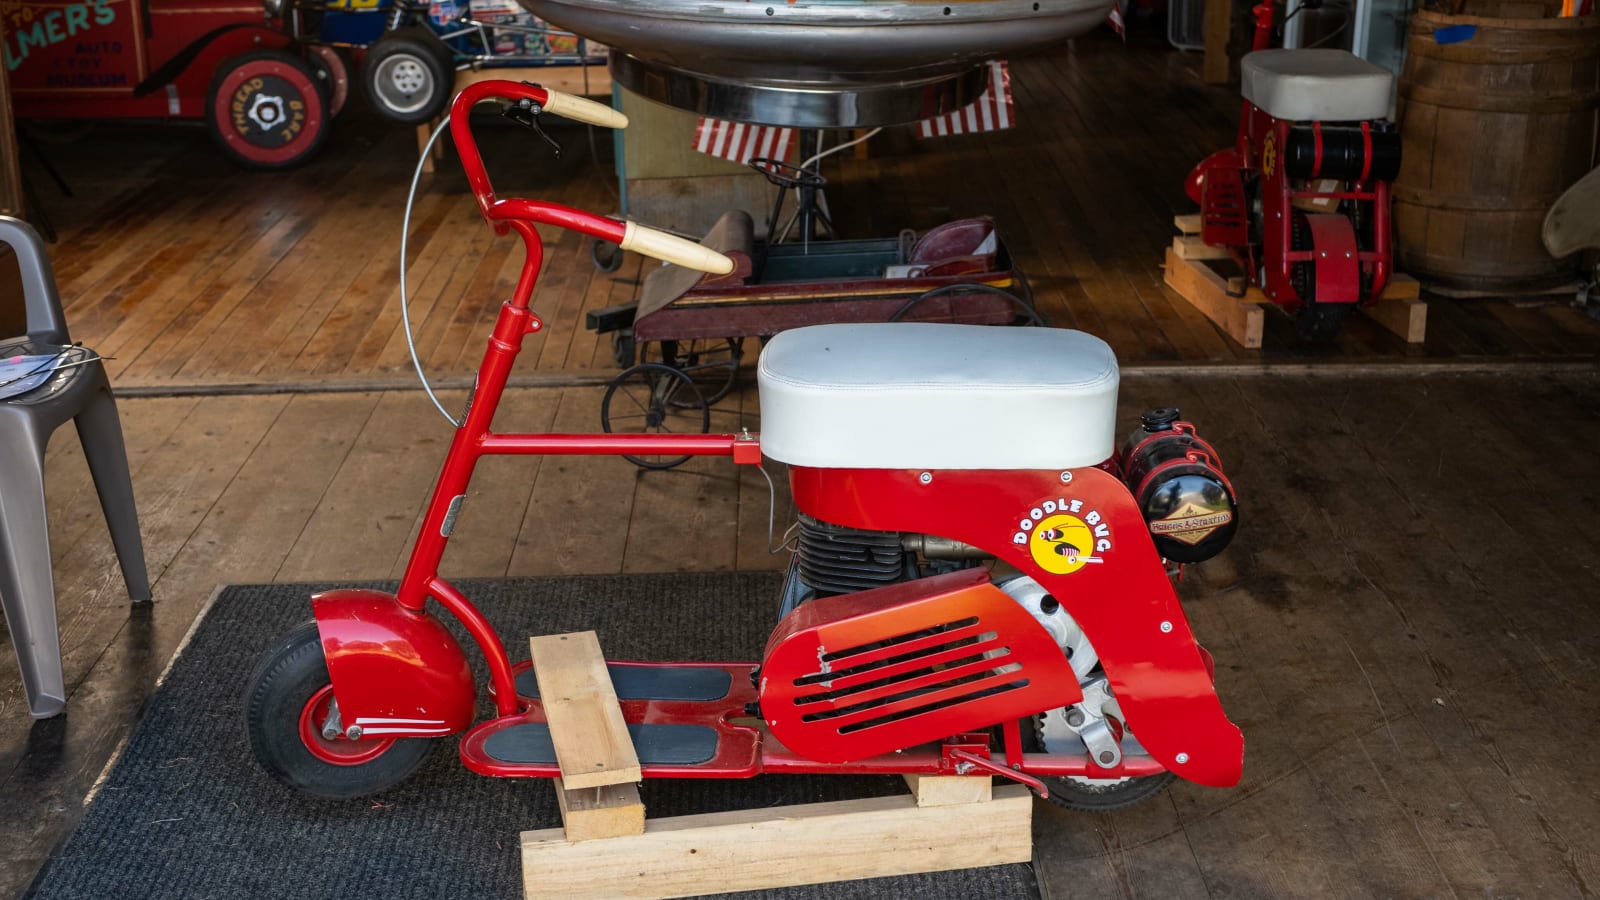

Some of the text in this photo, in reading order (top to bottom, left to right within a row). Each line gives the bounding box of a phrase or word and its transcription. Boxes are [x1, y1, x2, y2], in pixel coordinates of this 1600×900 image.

[76, 42, 122, 54] AUTO
[67, 58, 102, 68] TOY
[47, 73, 127, 87] MUSEUM
[232, 77, 264, 134] THREAD
[281, 100, 304, 141] BARE
[1013, 498, 1112, 552] DOODLE BUG
[1184, 520, 1191, 529] &
